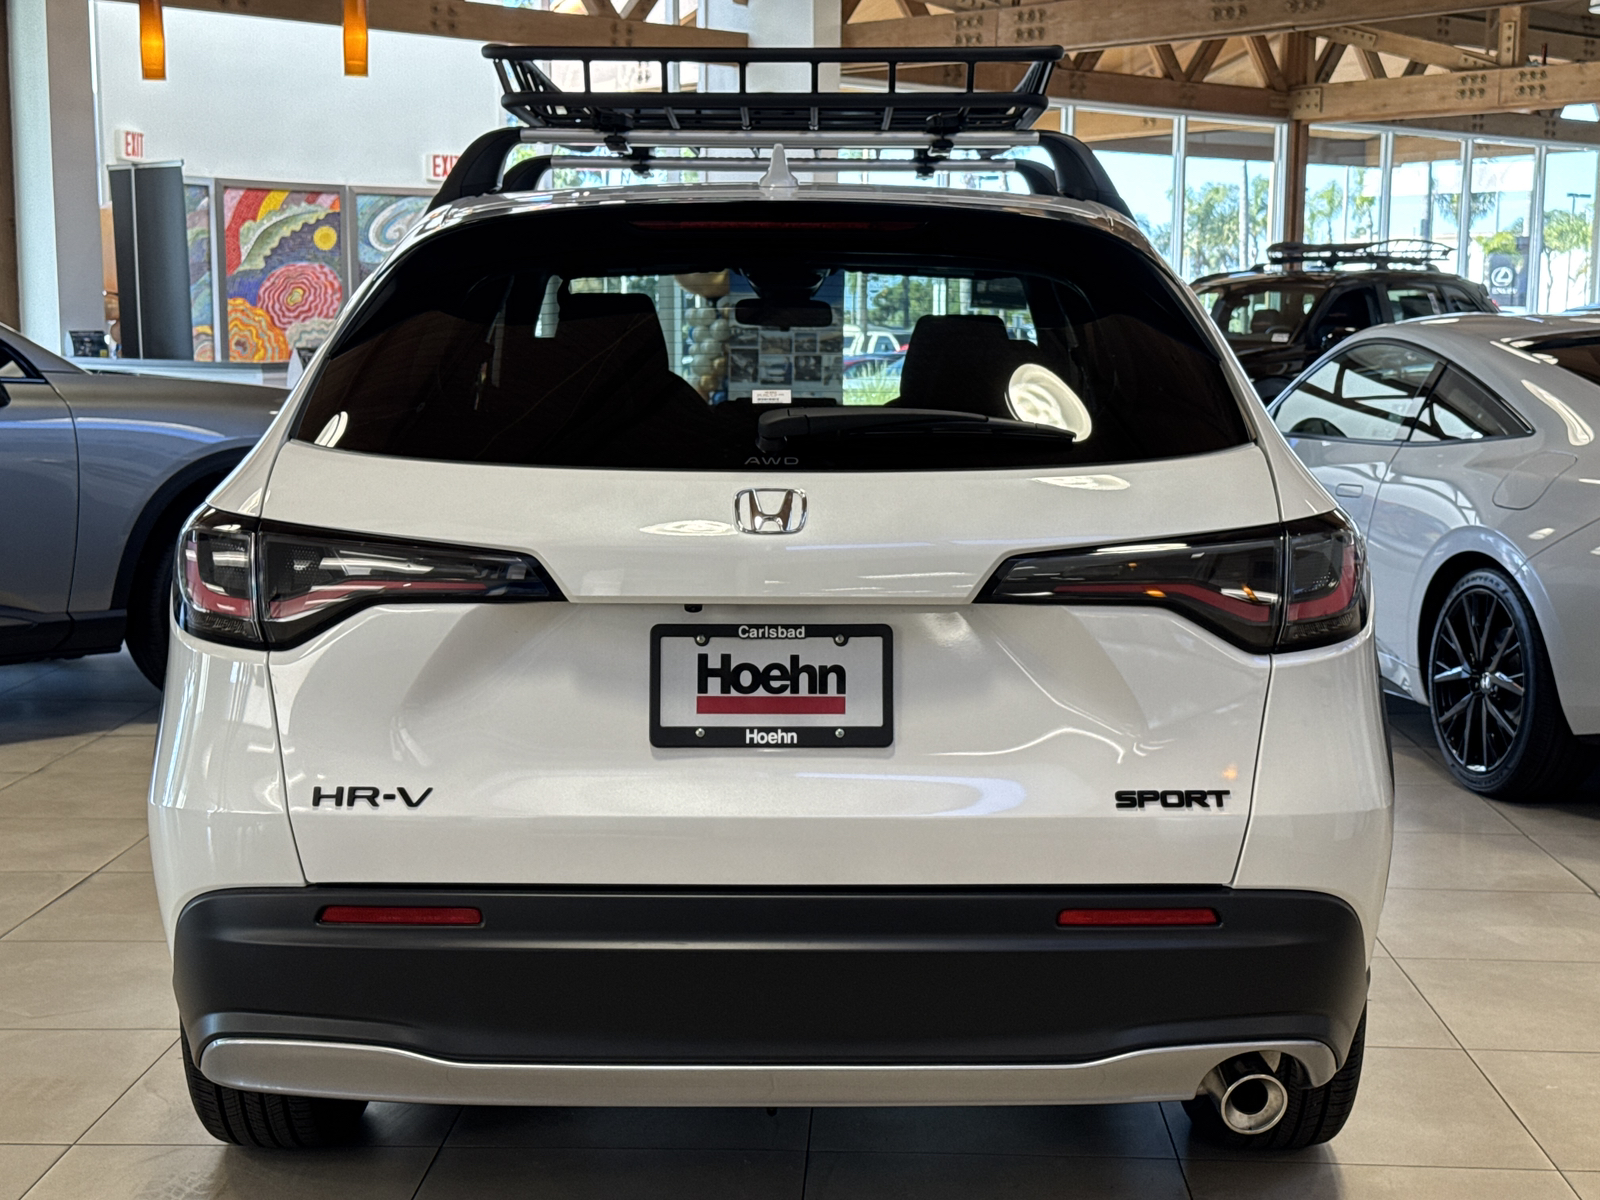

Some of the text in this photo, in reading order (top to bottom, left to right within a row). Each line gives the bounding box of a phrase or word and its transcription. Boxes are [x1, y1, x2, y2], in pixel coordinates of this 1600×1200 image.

[125, 131, 144, 158] EXIT
[432, 154, 460, 177] EXI
[744, 456, 799, 465] AWD
[738, 626, 806, 639] Carlsbad
[697, 653, 846, 694] Hoehn
[745, 729, 798, 744] Hoehn
[312, 786, 434, 807] HR-V
[1114, 790, 1231, 808] SPORT
